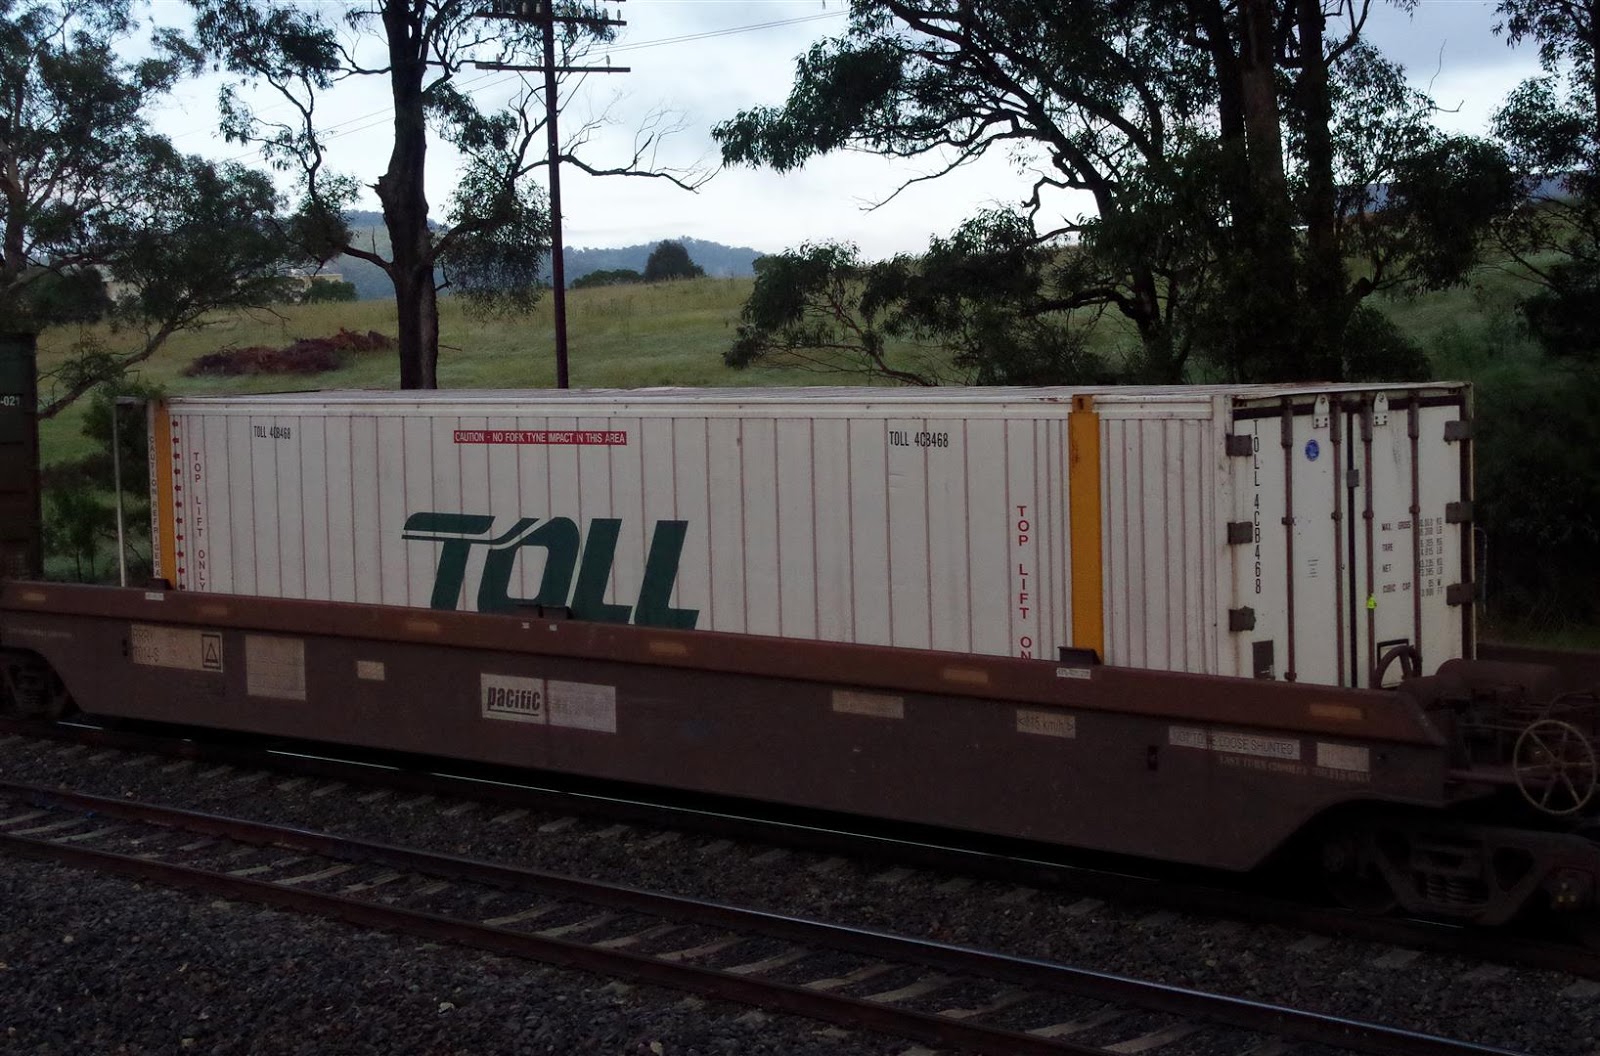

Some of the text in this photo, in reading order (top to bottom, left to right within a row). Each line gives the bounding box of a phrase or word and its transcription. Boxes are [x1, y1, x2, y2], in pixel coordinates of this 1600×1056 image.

[254, 425, 267, 438] TOLL
[454, 431, 485, 441] CAUTION
[492, 431, 503, 441] NO
[505, 432, 524, 442] FORK
[527, 432, 546, 442] TYNE
[548, 432, 574, 443] IMPACT
[576, 433, 583, 443] IN
[586, 433, 603, 443] THIS
[605, 433, 625, 443] AREA
[889, 431, 948, 447] TOLL 4CB468
[193, 452, 201, 482] TOP
[198, 549, 206, 591] ONLY
[1017, 505, 1030, 546] TOP
[1254, 494, 1262, 594] 4CB468
[401, 512, 700, 630] TOLL
[1019, 563, 1030, 619] LIFT
[487, 686, 541, 711] pacific
[1220, 735, 1249, 750] LOOSE
[1251, 739, 1294, 755] SHUNTED
